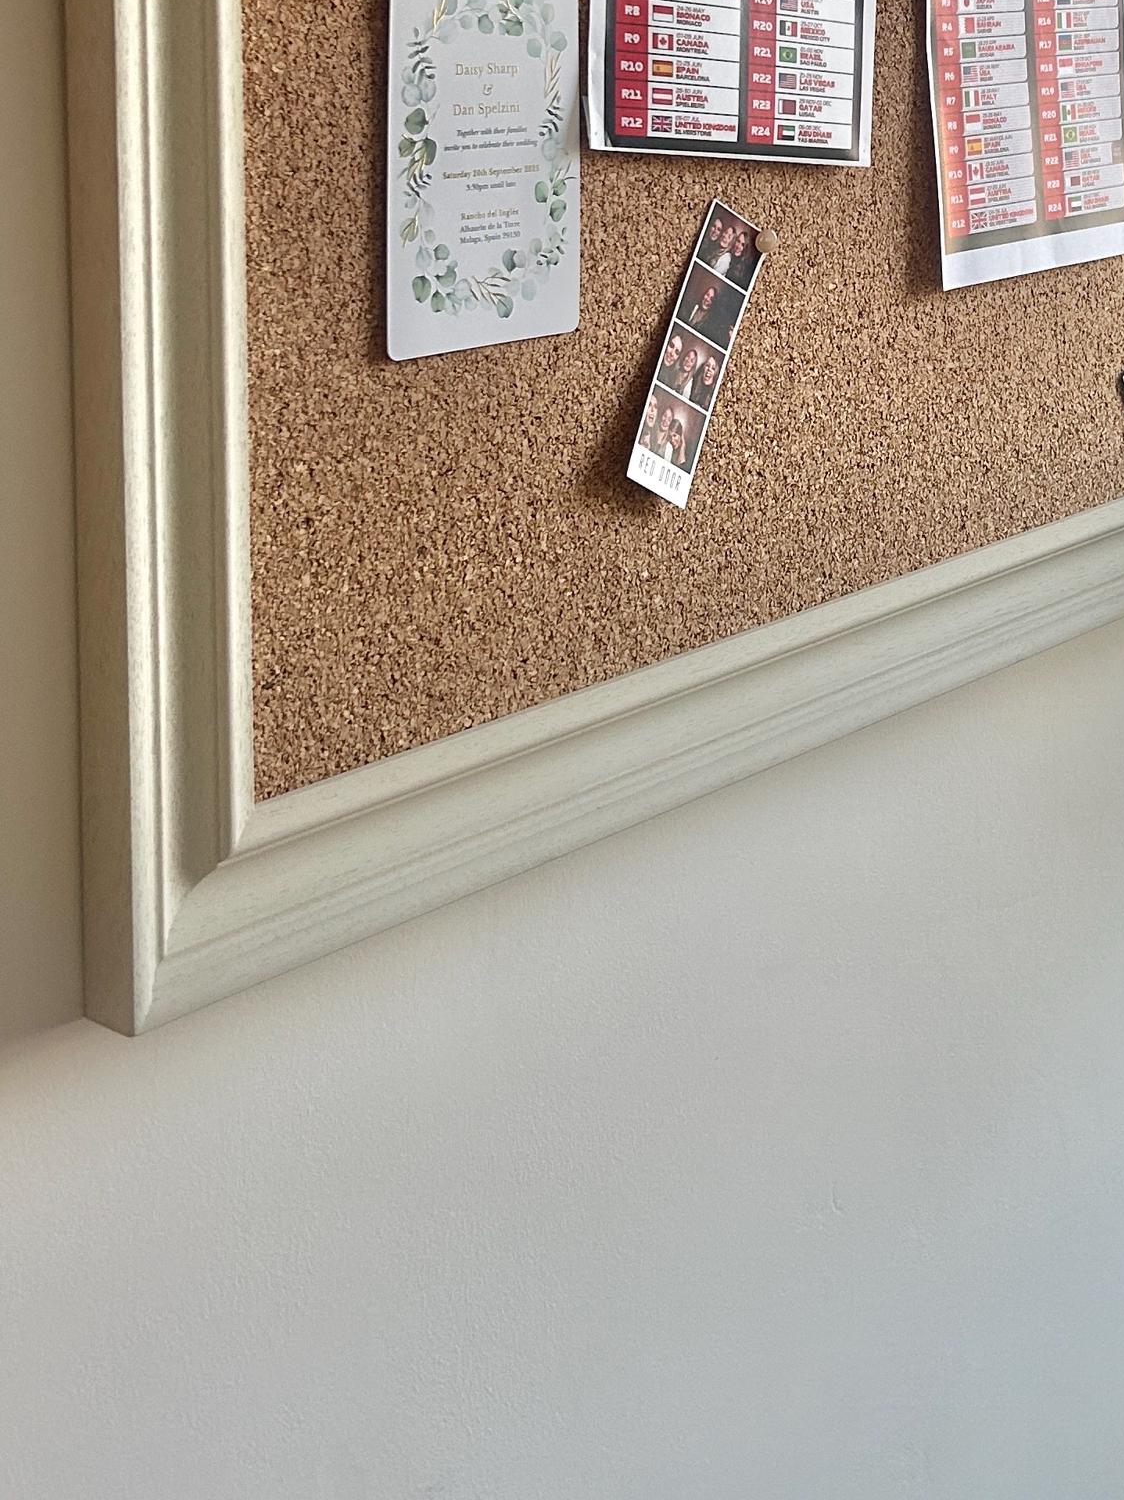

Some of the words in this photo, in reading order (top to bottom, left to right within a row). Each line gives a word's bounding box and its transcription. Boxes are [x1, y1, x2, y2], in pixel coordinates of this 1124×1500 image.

[801, 1, 814, 9] USA
[625, 5, 640, 15] R8
[676, 12, 710, 21] MONACO
[753, 20, 773, 31] R20
[624, 33, 640, 44] R9
[676, 39, 708, 48] CANADA
[1039, 41, 1052, 49] R17
[676, 47, 708, 55] MONTREAL
[754, 47, 771, 57] R21
[456, 64, 483, 78] Daisy
[488, 62, 517, 77] Sharp
[621, 61, 643, 72] R10
[676, 66, 699, 75] SPAIN
[1040, 64, 1053, 72] R18
[676, 74, 709, 82] BARCELONA
[753, 73, 771, 84] R22
[800, 78, 813, 86] LAS
[483, 84, 493, 95] &
[1041, 87, 1054, 95] R19
[622, 89, 642, 100] R11
[676, 94, 708, 103] AUSTRIA
[753, 100, 770, 110] R23
[946, 97, 956, 105] R7
[453, 104, 474, 116] Dan
[479, 102, 520, 118] Spelzini
[799, 104, 822, 112] QATAR
[1042, 111, 1056, 119] R20
[621, 117, 642, 128] R12
[675, 121, 701, 129] UNITED
[702, 123, 736, 132] KINGDOM
[752, 126, 770, 136] R24
[1044, 134, 1057, 142] R21
[1045, 157, 1059, 165] R22
[443, 171, 471, 179] Saturday
[489, 167, 522, 177] September
[1047, 180, 1060, 189] R23
[1048, 203, 1062, 212] R24
[487, 210, 497, 218] del
[639, 454, 656, 476] RED
[659, 466, 682, 491] DOOR
